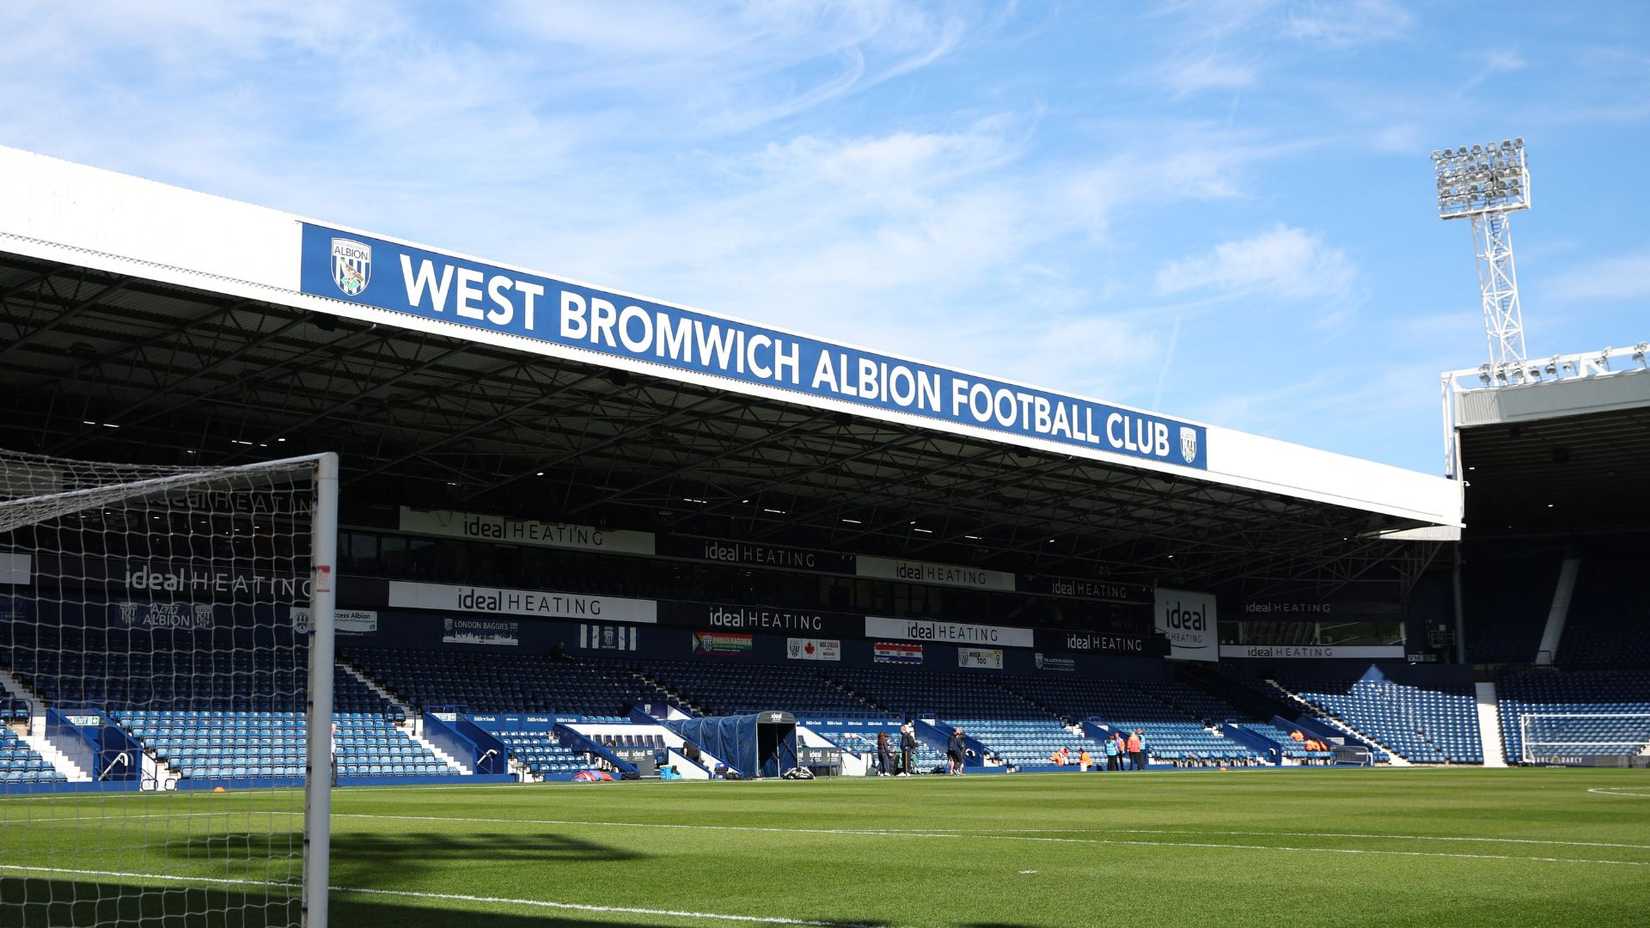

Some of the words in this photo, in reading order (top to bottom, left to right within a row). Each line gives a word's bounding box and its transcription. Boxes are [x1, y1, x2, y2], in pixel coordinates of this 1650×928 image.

[335, 246, 368, 260] ALBION
[400, 253, 544, 330] WEST
[560, 290, 800, 384] BROMWICH
[812, 349, 941, 411] ALBION
[952, 378, 1100, 443] FOOTBALL
[1106, 412, 1170, 456] CLUB
[464, 514, 507, 539] ideal
[513, 526, 603, 545] HEATING
[705, 541, 740, 562] ideal
[744, 545, 816, 568] HEATING
[125, 565, 184, 591] ideal
[896, 563, 924, 580] ideal
[927, 568, 986, 584] HEATING
[1052, 577, 1076, 595] ideal
[1078, 583, 1128, 599] HEATING
[458, 588, 502, 611] ideal
[508, 594, 601, 615] HEATING
[1246, 599, 1271, 613] ideal
[1274, 602, 1331, 614] HEATING
[143, 614, 190, 627] ALBION
[709, 607, 744, 627] ideal
[749, 612, 823, 630] HEATING
[1166, 600, 1206, 631] ideal
[907, 622, 935, 639] ideal
[939, 625, 998, 641] HEATING
[1067, 632, 1091, 649] ideal
[1093, 637, 1143, 651] HEATING
[1248, 647, 1273, 657] ideal
[1276, 648, 1333, 657] HEATING
